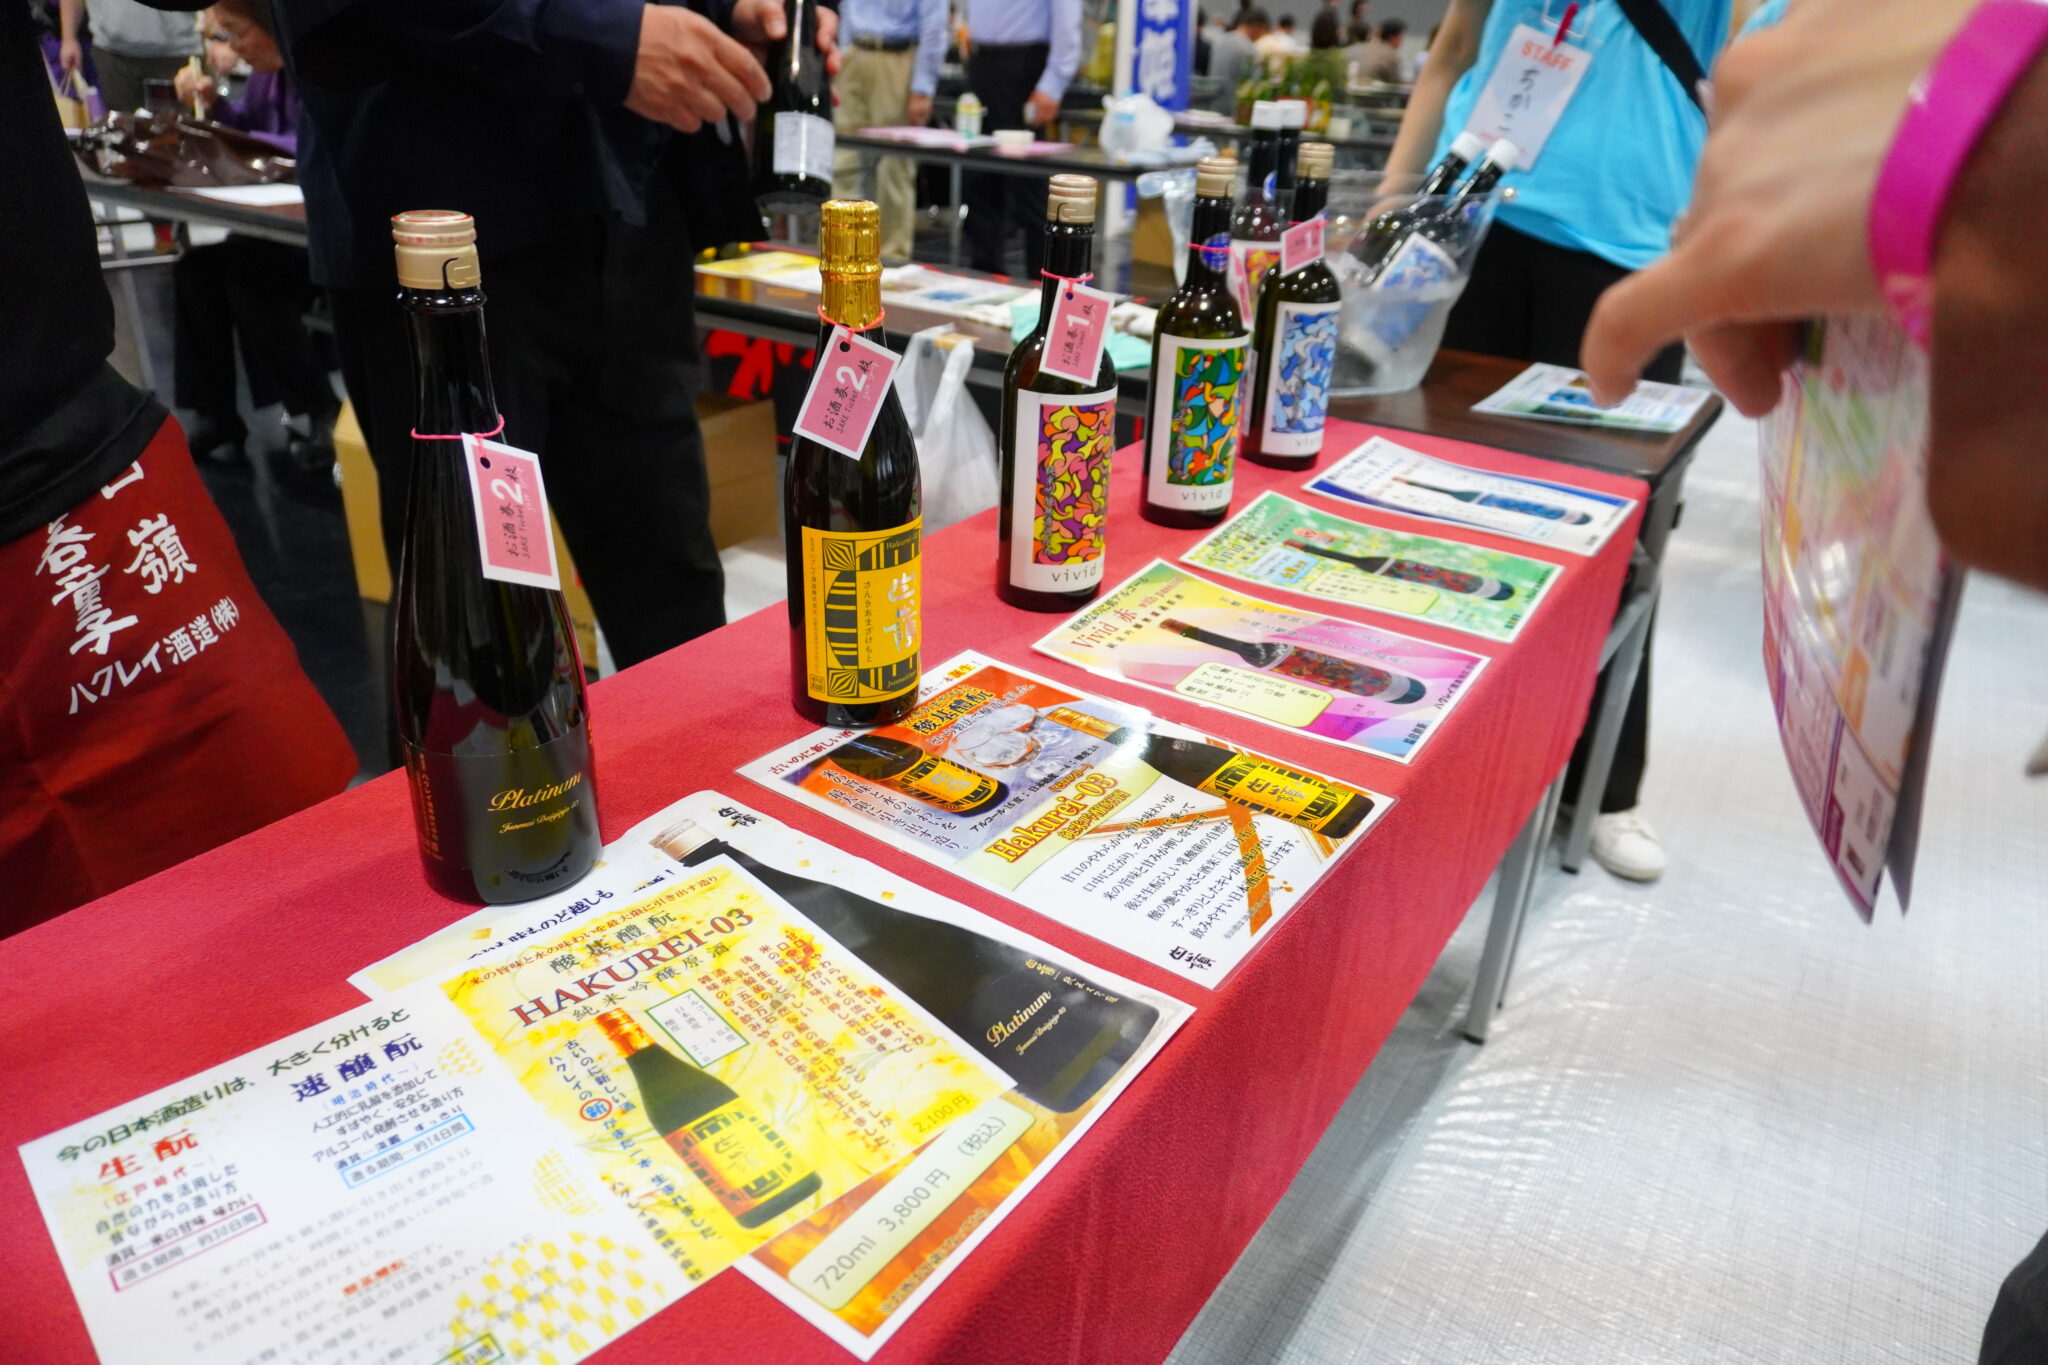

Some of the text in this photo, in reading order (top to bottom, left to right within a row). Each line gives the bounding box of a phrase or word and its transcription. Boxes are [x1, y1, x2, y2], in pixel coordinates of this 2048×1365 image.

[1521, 40, 1575, 71] STAFF
[1181, 487, 1224, 501] vivid
[1051, 563, 1099, 582] vivid
[1068, 620, 1121, 649] Vivid
[1107, 606, 1142, 622] 赤
[767, 728, 856, 776] 古いのに新しい酒
[488, 772, 582, 812] Platinum
[818, 768, 959, 832] 米の旨味と水の味わいを
[983, 771, 1121, 863] Hakurei-03
[499, 819, 534, 834] Junmai
[824, 788, 971, 856] 最大限に引き出す造り。
[509, 906, 757, 1027] HAKUREI-03
[569, 941, 731, 1021] 純米吟醸原酒
[986, 990, 1052, 1047] Platinum
[561, 1038, 638, 1113] 古いのに新しい酒
[814, 1235, 877, 1290] 720ml
